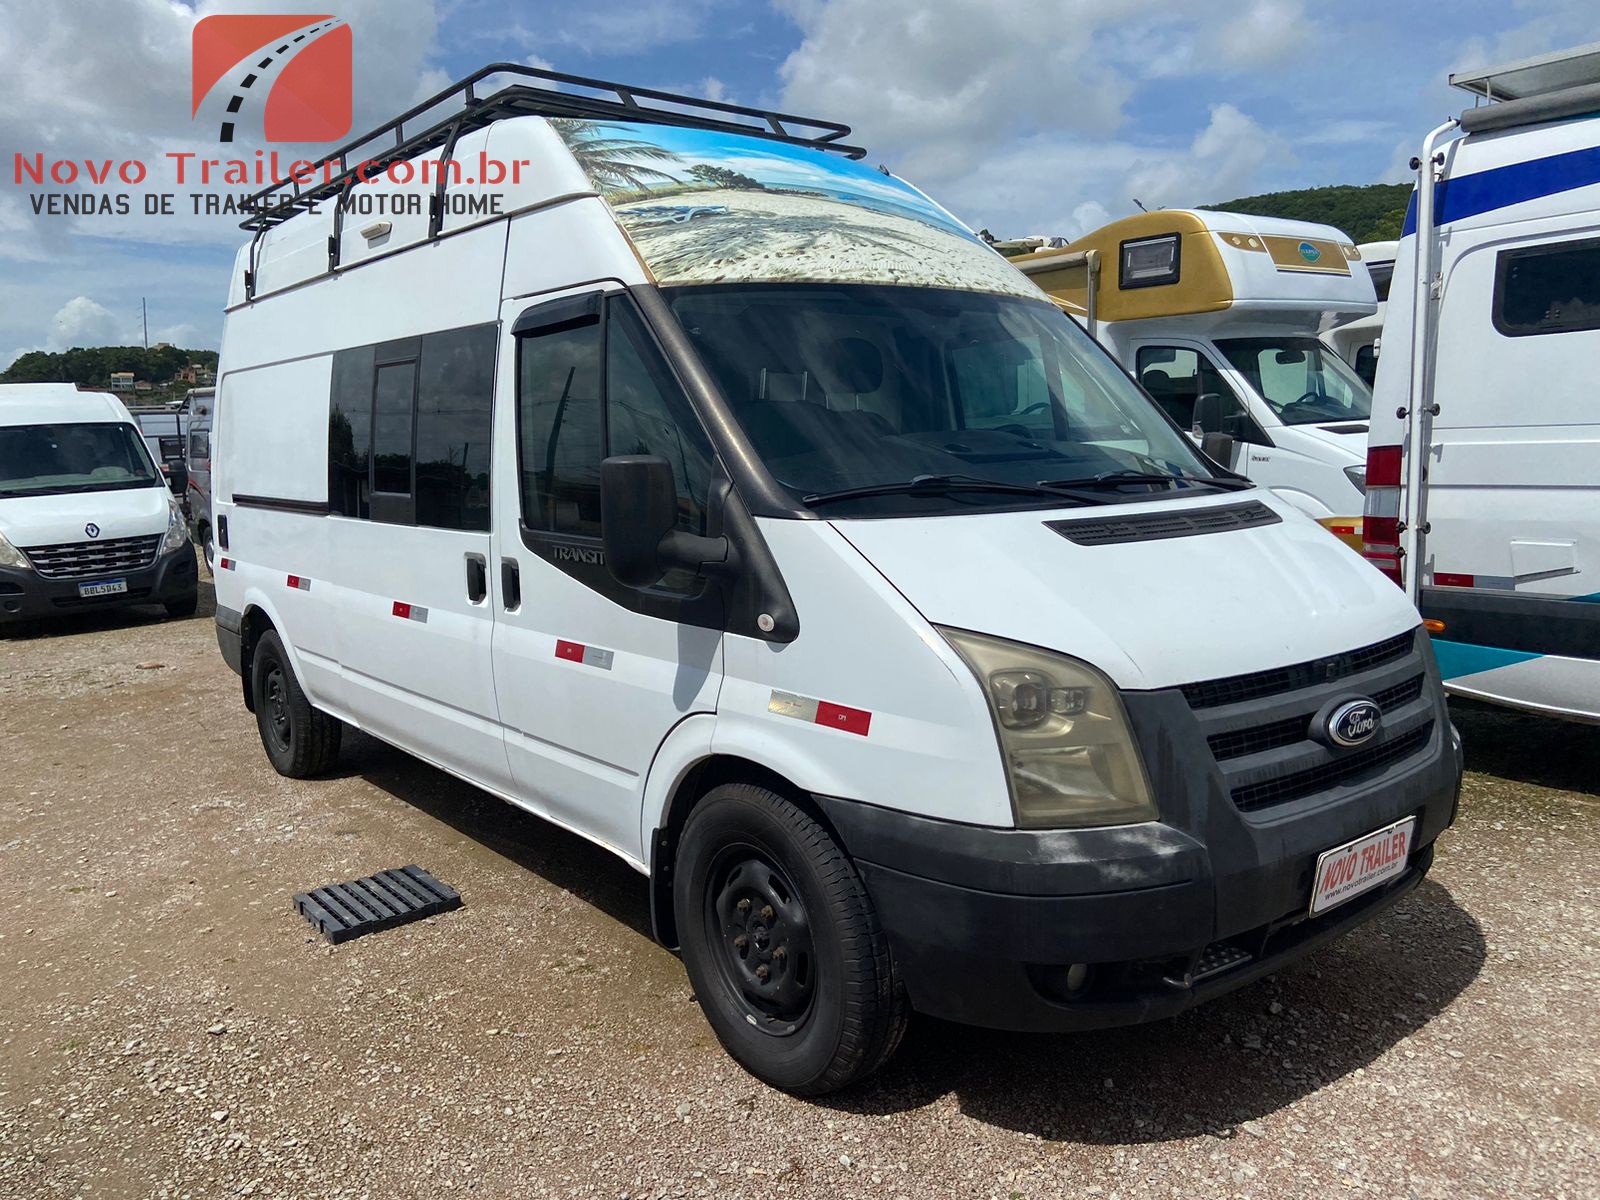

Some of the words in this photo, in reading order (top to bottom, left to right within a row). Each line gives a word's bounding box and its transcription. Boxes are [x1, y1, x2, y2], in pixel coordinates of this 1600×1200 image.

[551, 545, 605, 565] TRANSIT
[1347, 709, 1374, 737] Ford
[1319, 851, 1358, 894] NOVO
[1359, 831, 1406, 876] TRAILER
[1324, 861, 1398, 901] www.novotrailer.com.br
